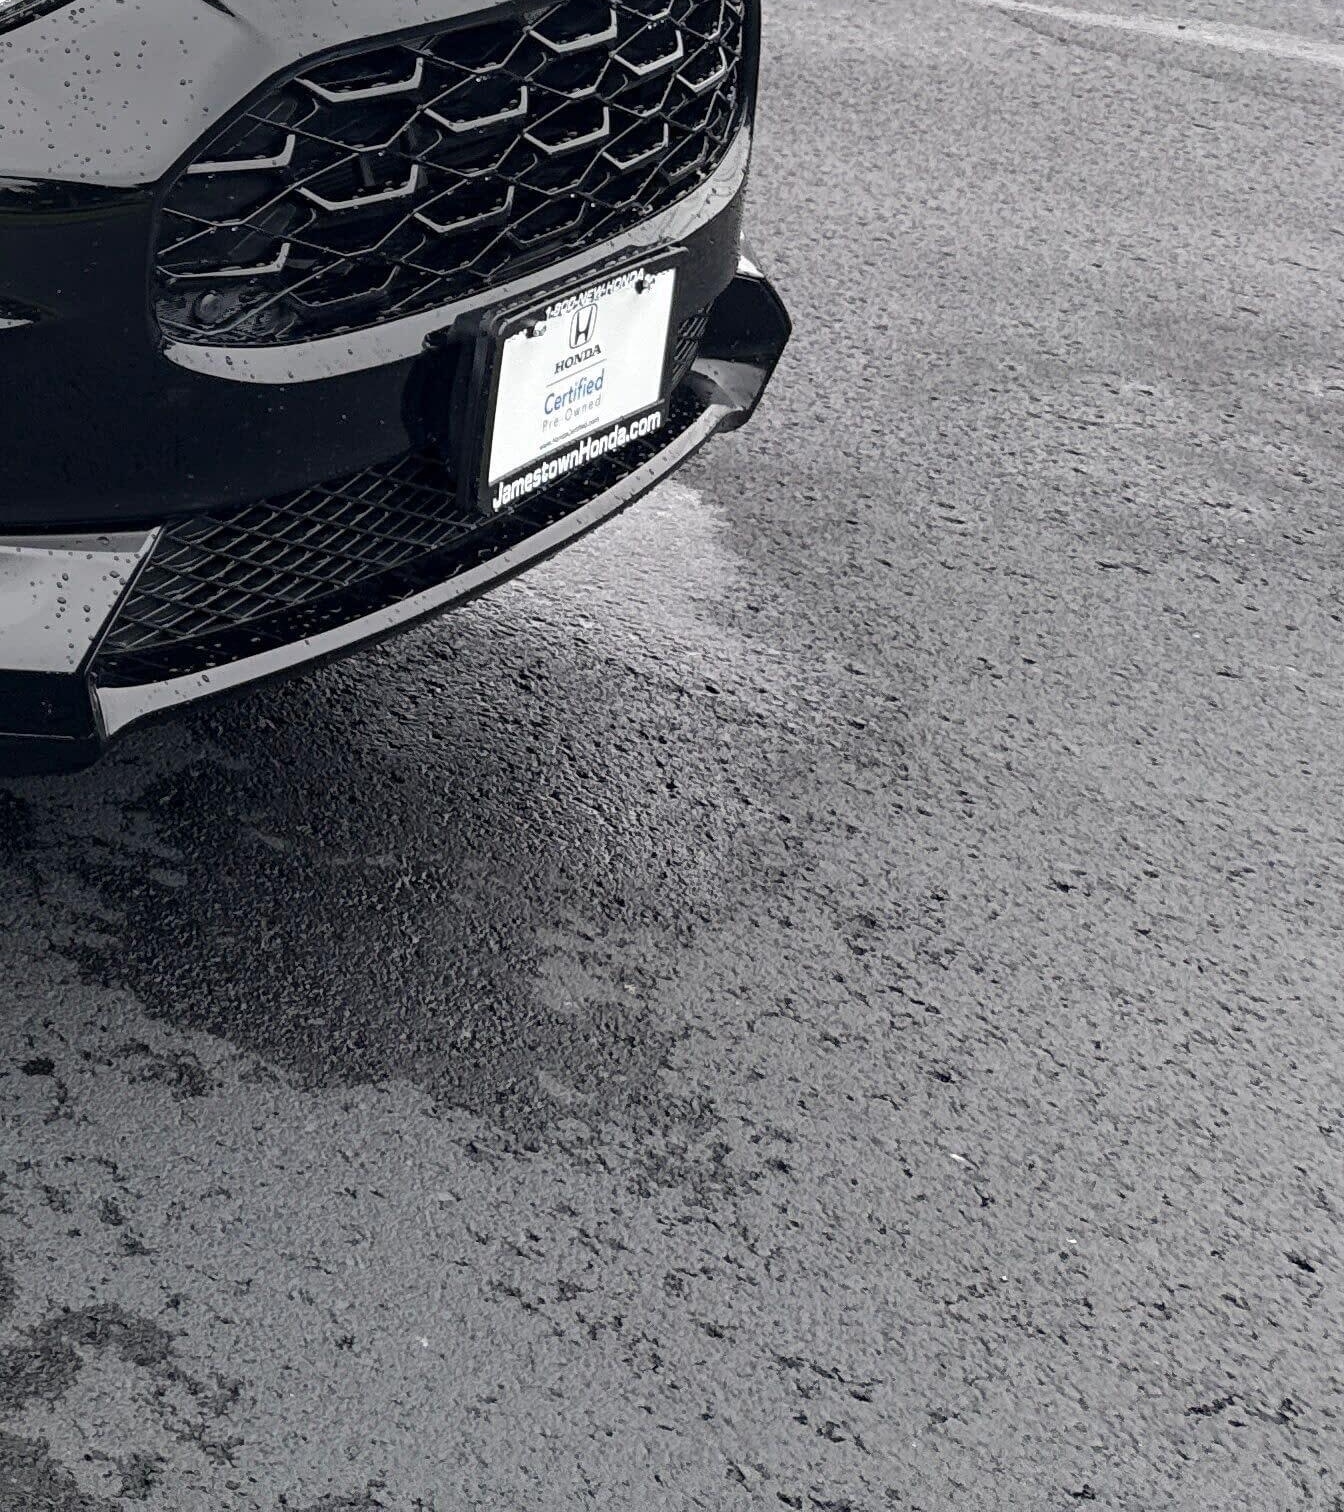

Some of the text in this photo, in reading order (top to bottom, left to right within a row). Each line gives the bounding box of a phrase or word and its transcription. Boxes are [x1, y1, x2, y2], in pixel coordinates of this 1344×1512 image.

[554, 345, 601, 375] HONDA
[544, 368, 604, 414] Certified
[493, 412, 661, 511] JamestownHonda.com
